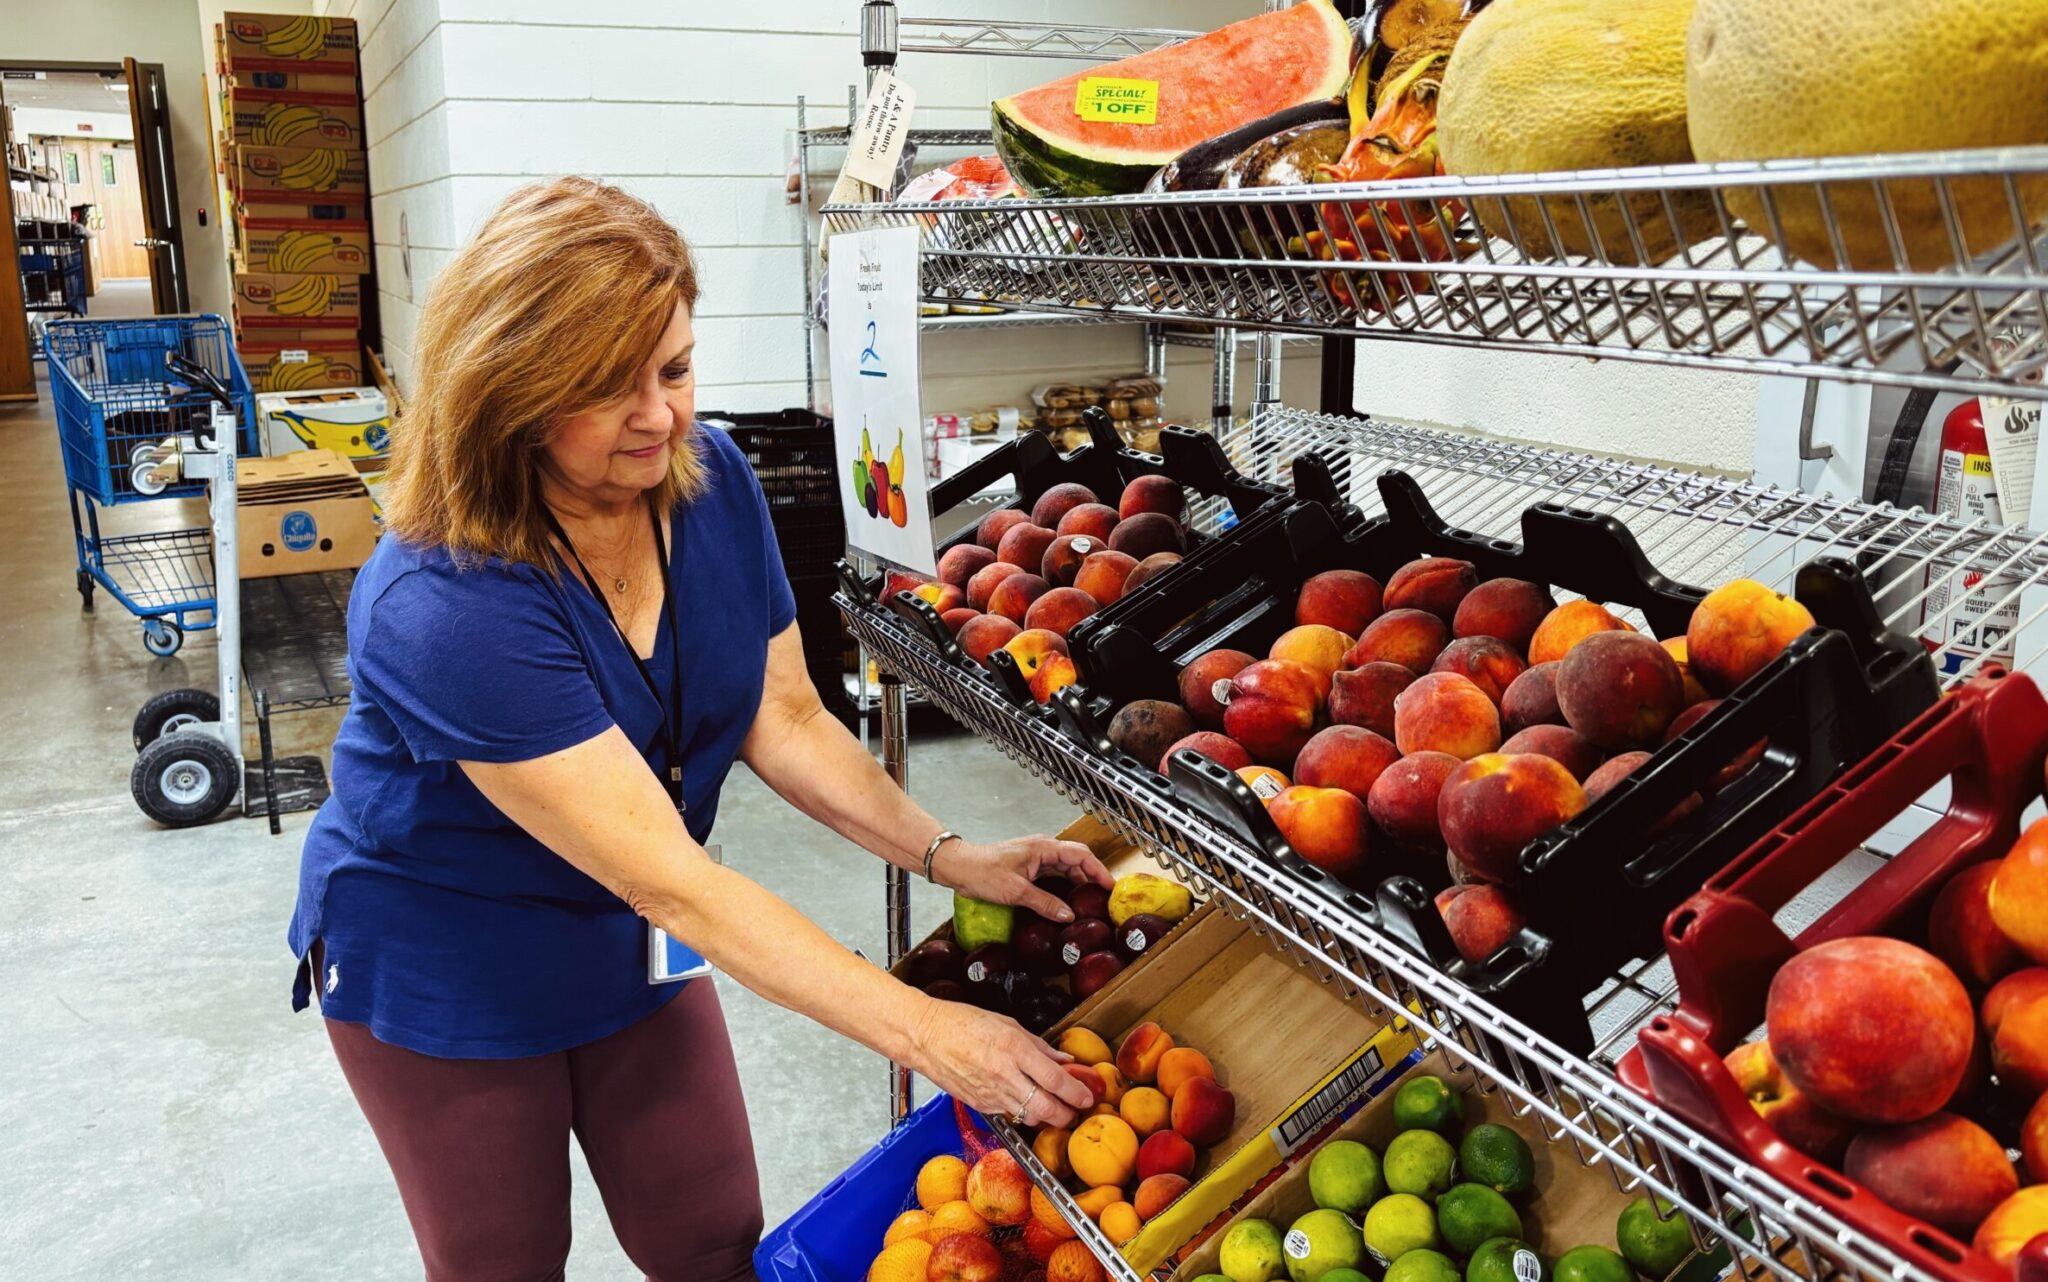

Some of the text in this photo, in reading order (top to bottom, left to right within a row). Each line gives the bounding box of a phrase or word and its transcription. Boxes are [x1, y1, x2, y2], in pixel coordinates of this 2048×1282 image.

[237, 23, 263, 37] Dole
[1095, 88, 1147, 98] SPECIAL!
[893, 103, 902, 112] &
[1106, 103, 1146, 114] OFF
[865, 104, 879, 130] Reuse.
[866, 83, 897, 161] Do not throw away!
[890, 113, 898, 121] A
[878, 123, 897, 156] Pantry
[247, 285, 272, 298] Dole
[861, 320, 880, 365] 2
[226, 453, 234, 482] COSCO
[1968, 502, 1984, 510] RING
[1965, 598, 1997, 608] SQUEEZ
